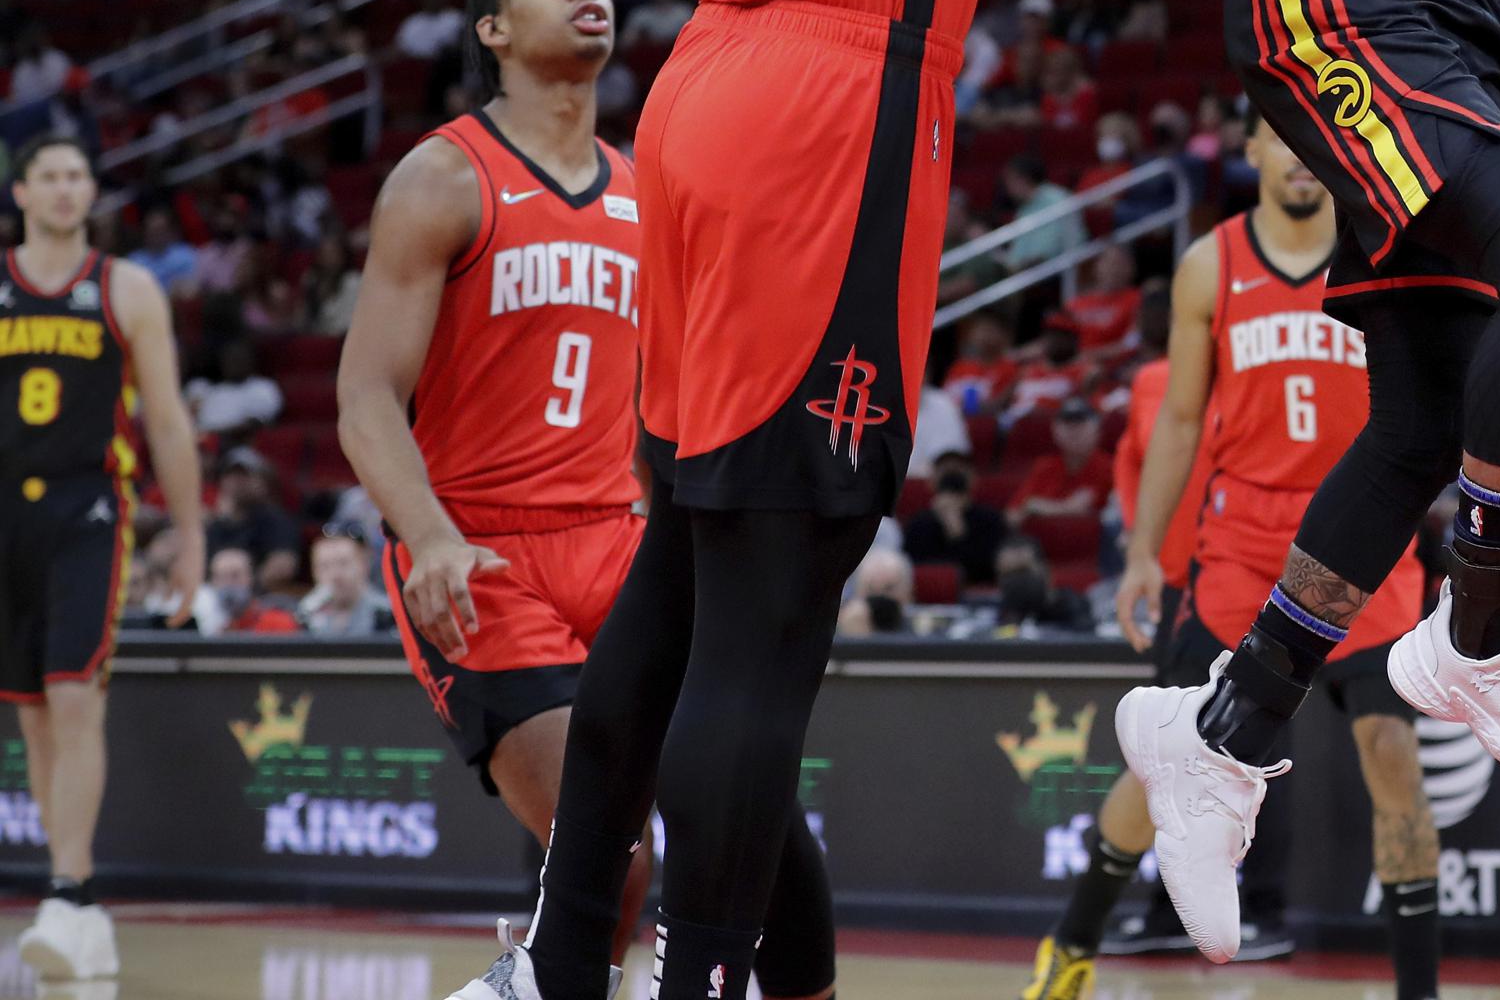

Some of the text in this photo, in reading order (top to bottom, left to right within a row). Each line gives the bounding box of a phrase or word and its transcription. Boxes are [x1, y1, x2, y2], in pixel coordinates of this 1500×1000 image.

[490, 241, 639, 328] ROCKET
[1229, 310, 1368, 374] ROCKETS
[19, 367, 62, 425] 8
[545, 331, 592, 428] 9
[1284, 374, 1318, 443] 6
[263, 793, 438, 857] KINGS
